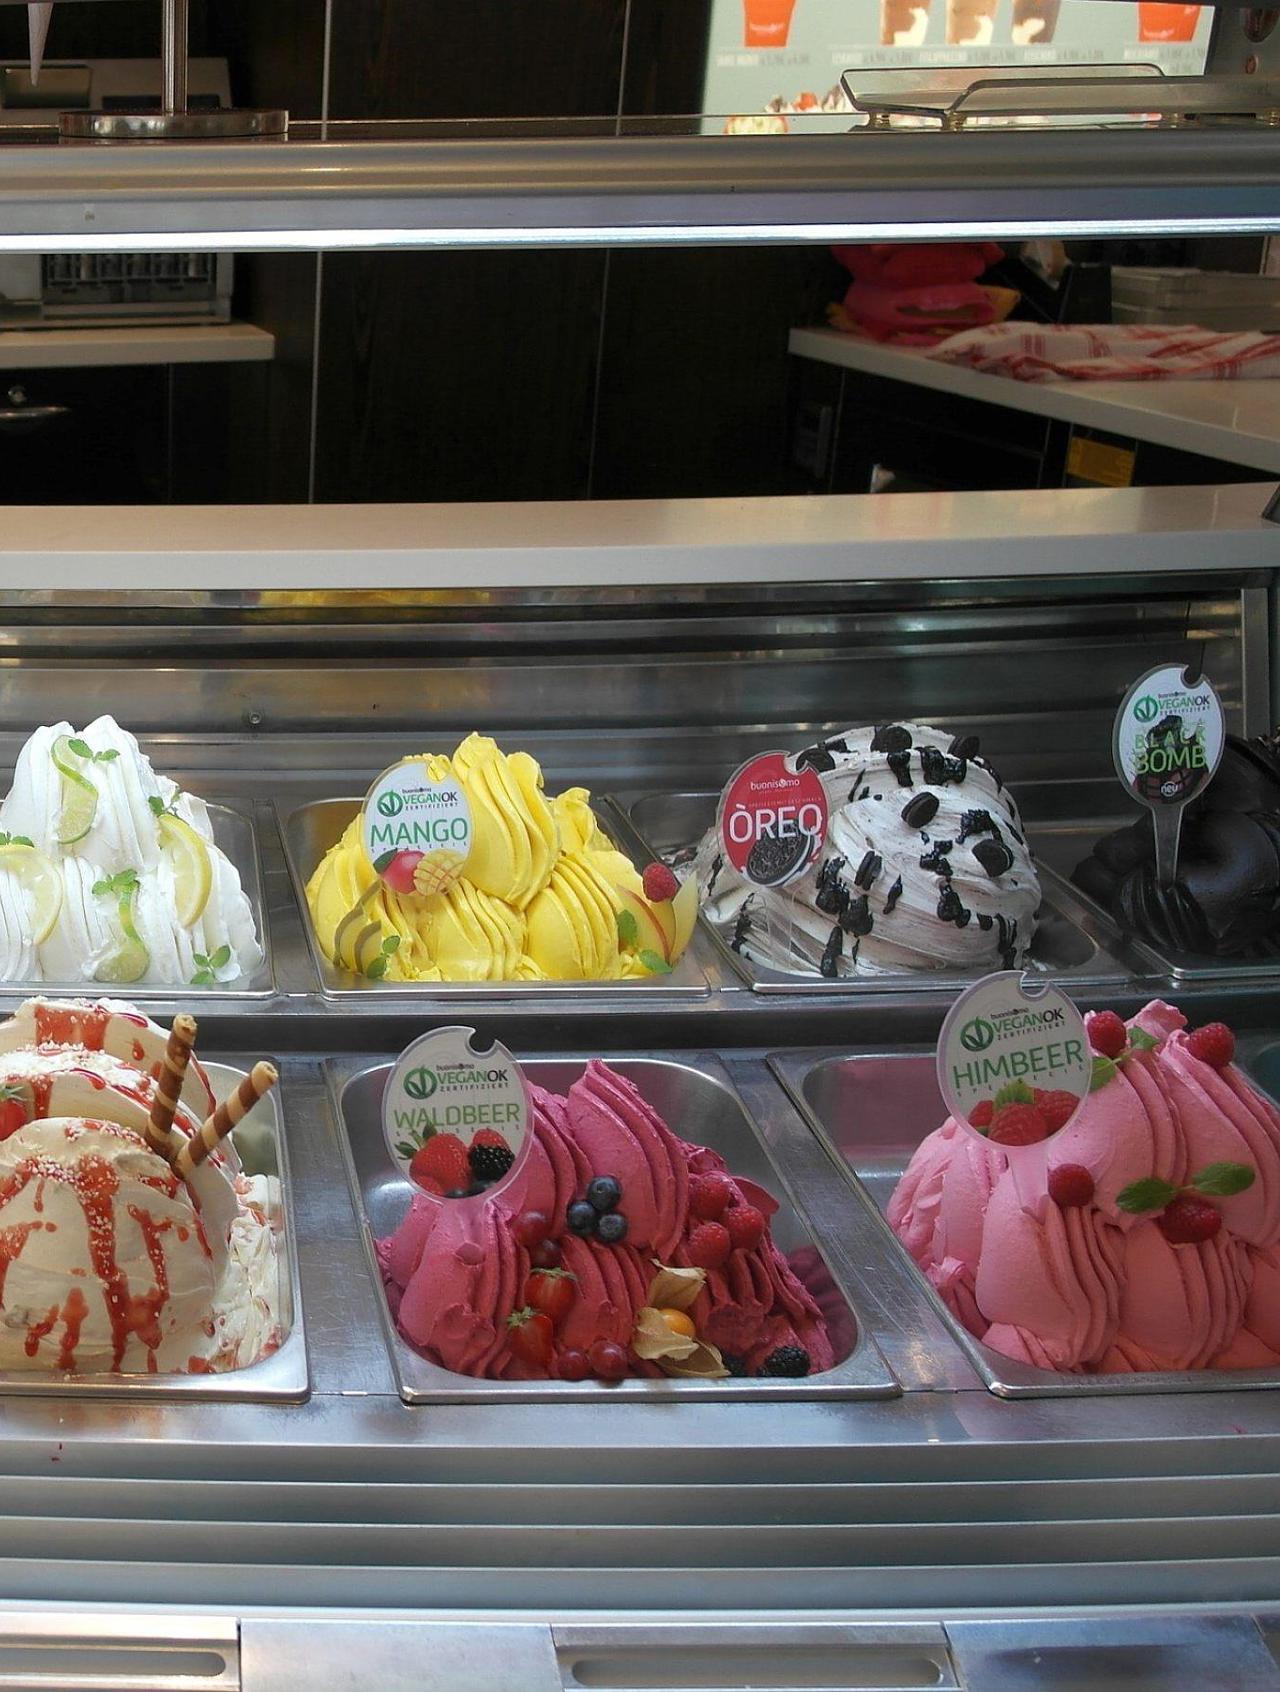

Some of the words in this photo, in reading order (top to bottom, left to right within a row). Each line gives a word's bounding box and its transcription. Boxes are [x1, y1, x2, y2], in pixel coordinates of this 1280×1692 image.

[1135, 725, 1207, 749] BLACK
[1160, 784, 1178, 794] neu
[370, 817, 468, 847] MANGO
[953, 1040, 1083, 1089] HIMBEER
[393, 1103, 520, 1128] WALDBEER
